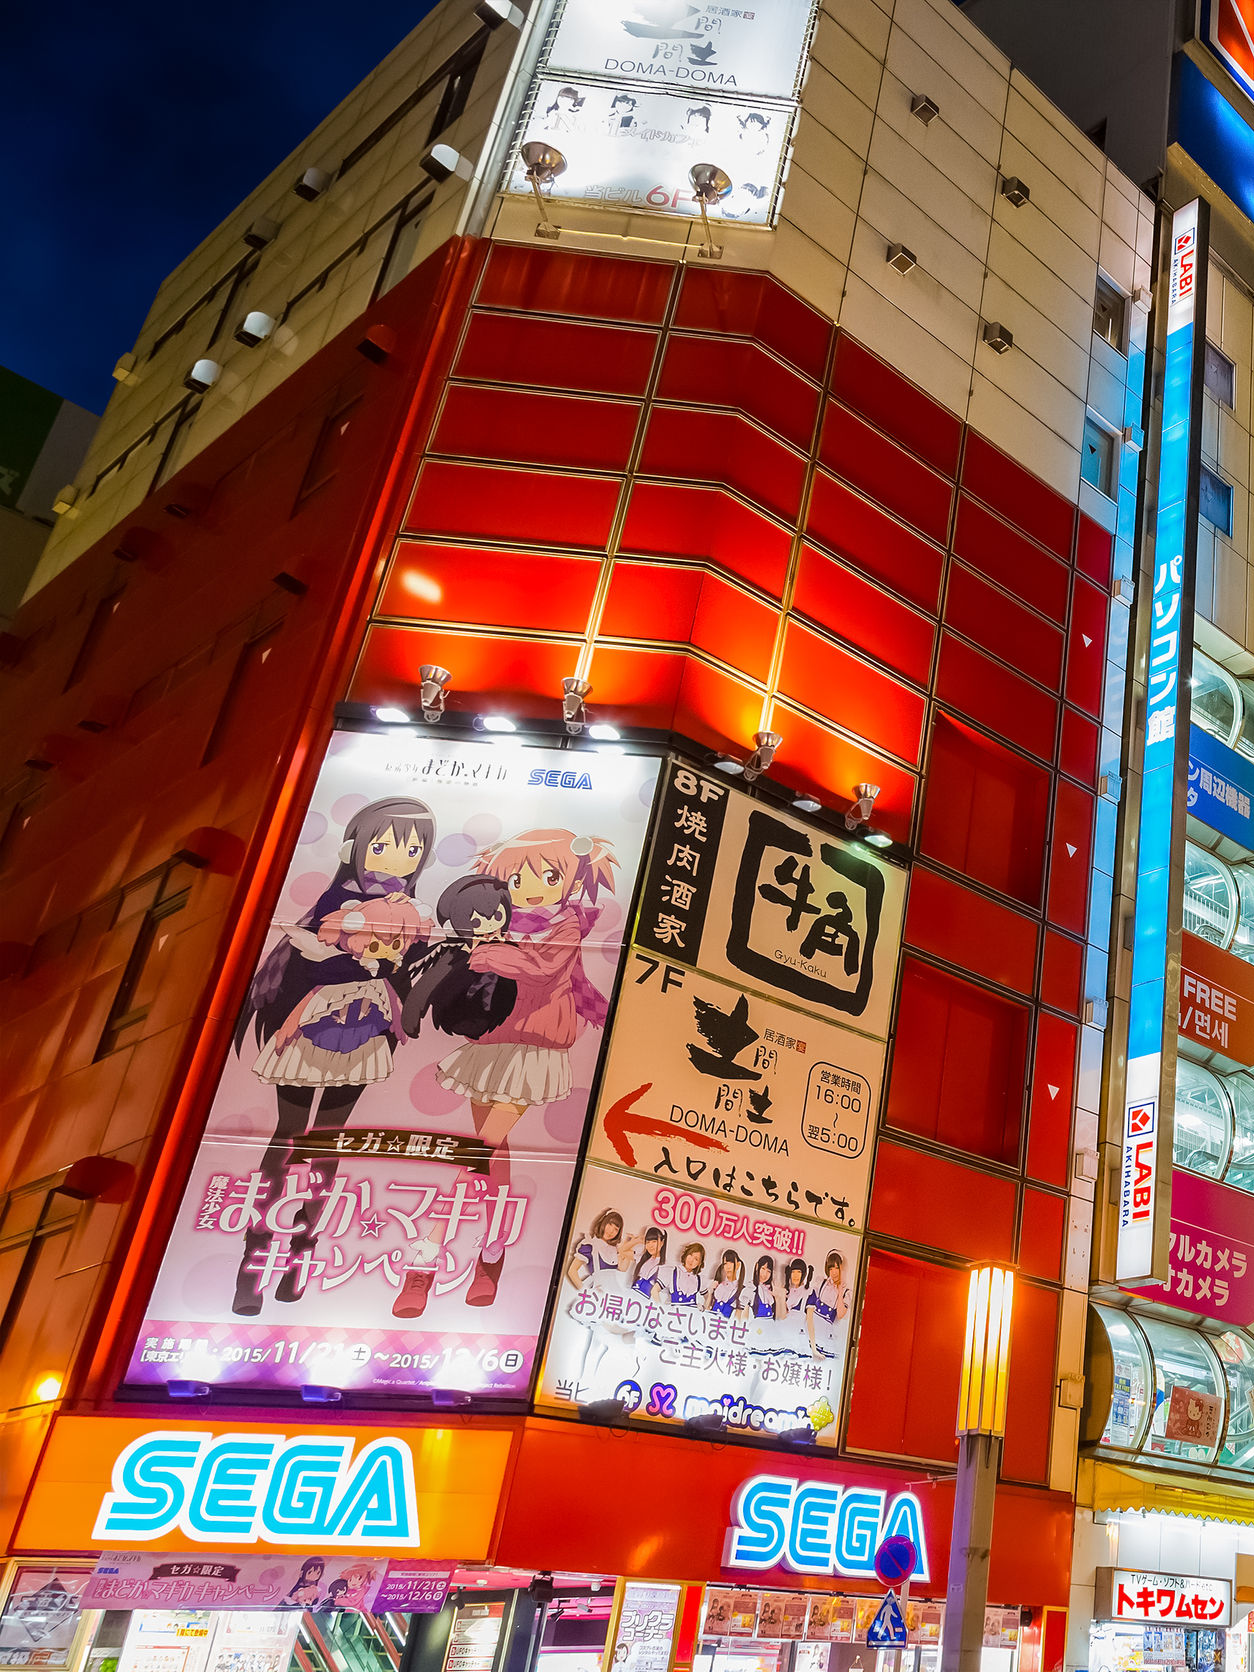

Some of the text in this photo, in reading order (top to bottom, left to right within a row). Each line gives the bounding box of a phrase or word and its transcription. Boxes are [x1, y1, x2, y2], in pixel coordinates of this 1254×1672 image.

[604, 58, 738, 87] DOMA-DOMA
[645, 185, 693, 209] 6F
[1178, 250, 1194, 297] LABI
[1146, 554, 1183, 746] パソコン館
[527, 768, 593, 790] SEGA
[673, 769, 725, 804] 8F
[652, 804, 708, 949] 焼肉酒家
[757, 855, 860, 977] 牛角
[635, 954, 686, 994] 7F
[774, 949, 828, 979] Gyu-Kaku
[1183, 974, 1237, 1022] FREE
[763, 1028, 796, 1049] 居酒家
[815, 1084, 862, 1113] 16:00
[820, 1070, 862, 1095] 営業時間
[669, 1104, 790, 1157] DOMA-DOMA
[807, 1123, 859, 1152] 翌5:00
[196, 1175, 230, 1231] 魔法少女
[653, 1145, 856, 1229] 入口はこちらです。
[1121, 1145, 1133, 1229] AKIHABARA
[1131, 1140, 1154, 1225] LABI
[652, 1190, 807, 1256] 300万人突破!!
[246, 1240, 476, 1297] キャンペーン
[574, 1288, 750, 1347] お帰りなさいませ
[92, 1430, 421, 1548] SEGA
[735, 1473, 931, 1584] SEGA
[195, 1581, 281, 1602] キャンペーン
[1117, 1583, 1225, 1621] トキワムセン
[621, 1610, 675, 1631] プリクラ
[623, 1627, 664, 1642] コーナー
